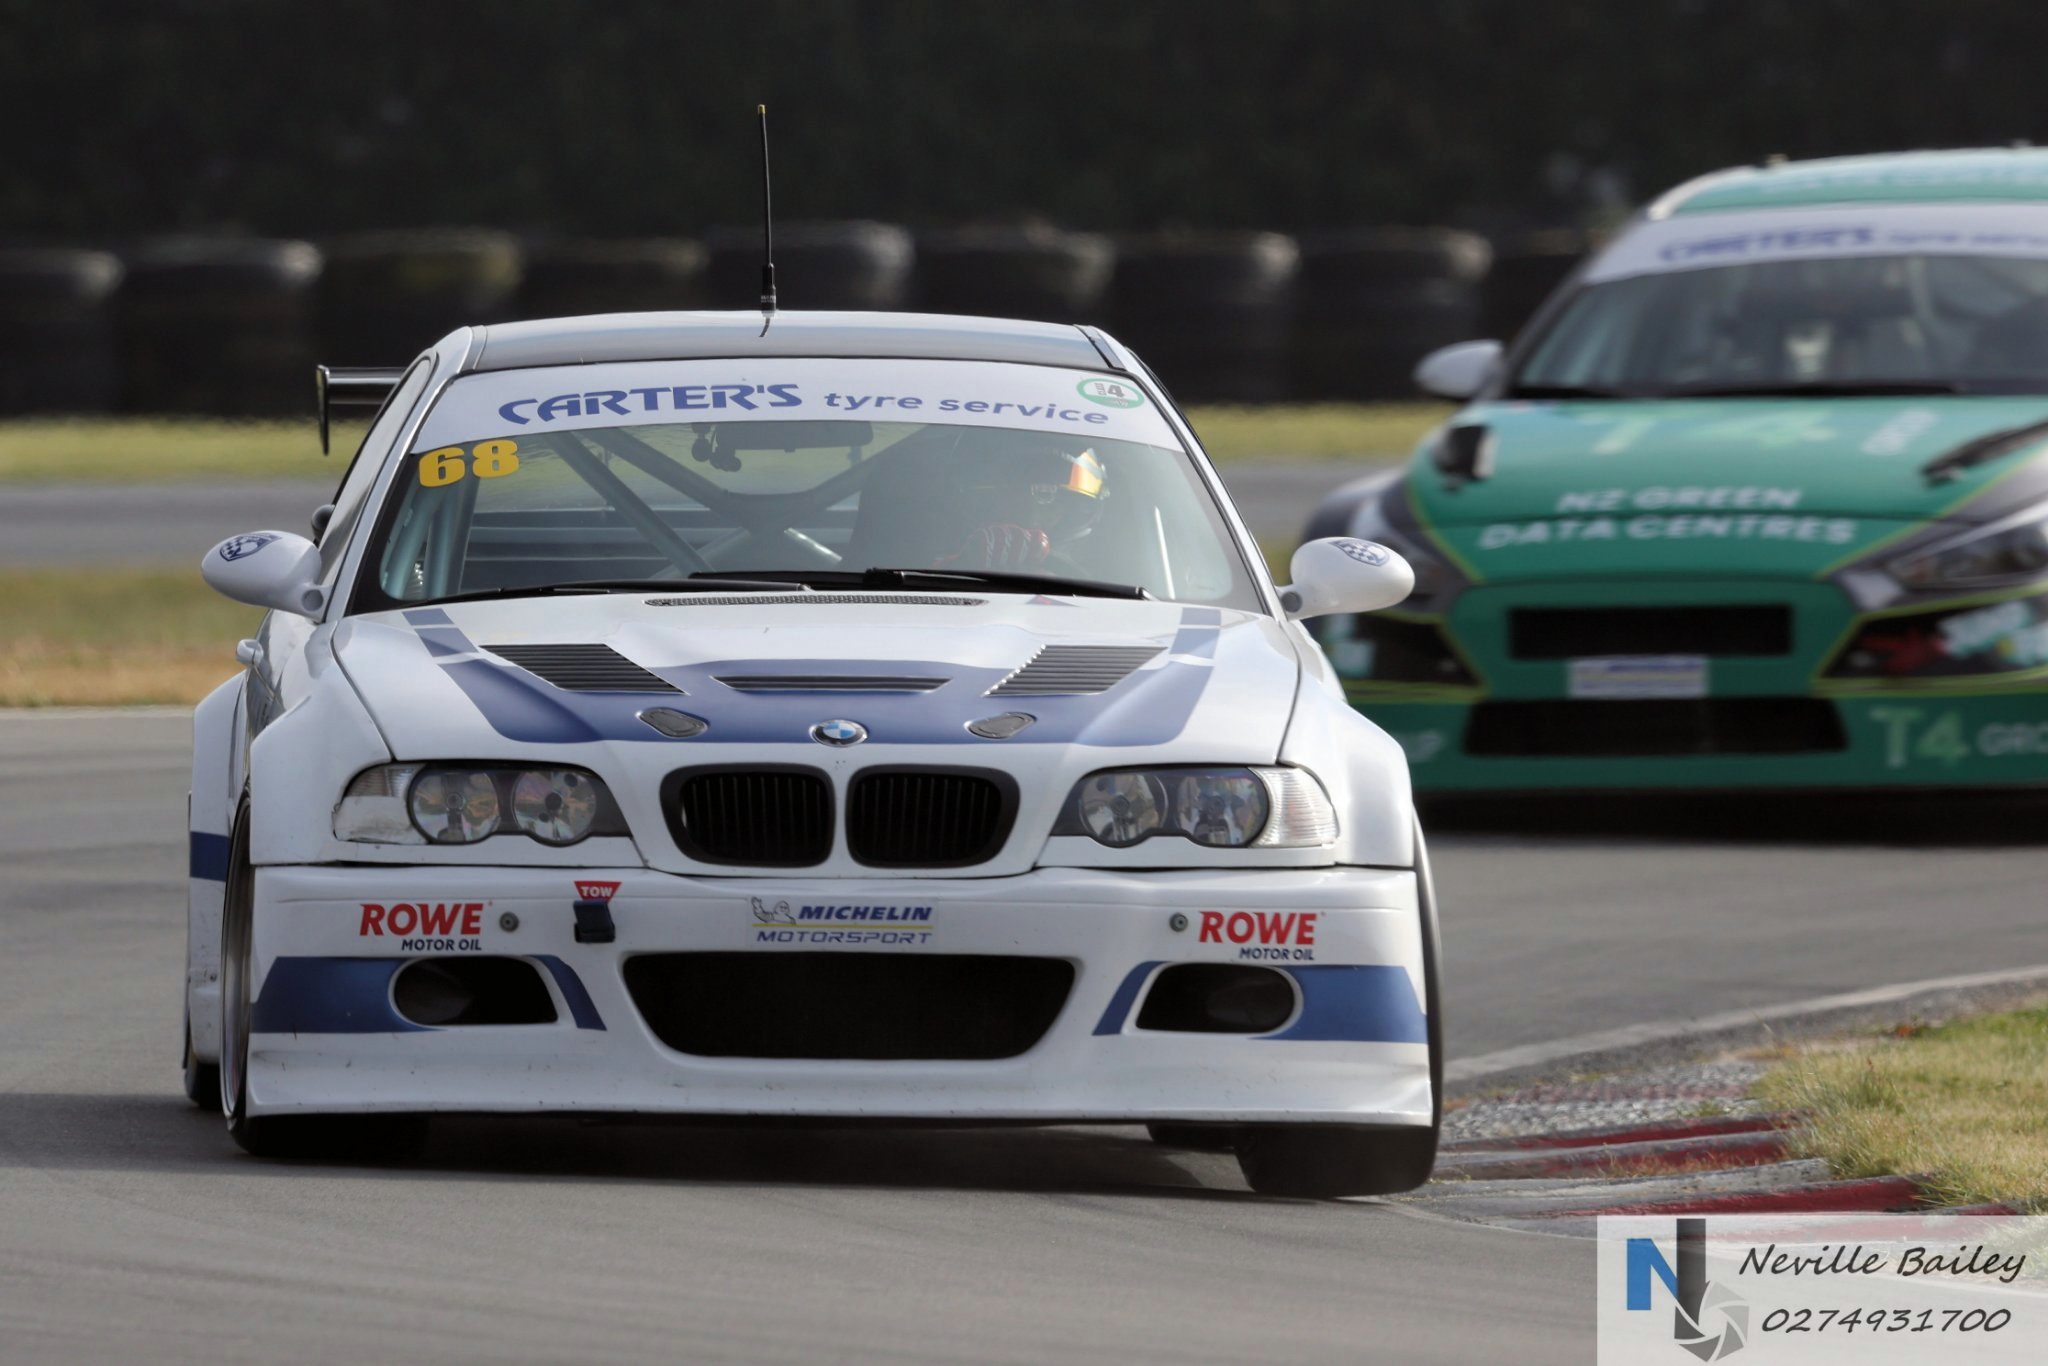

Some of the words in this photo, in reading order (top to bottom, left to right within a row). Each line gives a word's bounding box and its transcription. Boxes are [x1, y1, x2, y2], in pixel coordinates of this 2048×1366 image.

[497, 383, 803, 425] CARTER'S
[824, 391, 924, 411] tyre
[938, 398, 1110, 424] service
[418, 439, 520, 488] 68
[1633, 485, 1801, 511] GREEN
[1479, 519, 1616, 549] DATA
[1625, 512, 1857, 546] CENTRES
[1869, 706, 1969, 769] T4
[581, 886, 613, 898] TOW
[359, 903, 484, 937] ROWE
[798, 906, 933, 921] MICHELIN
[1198, 911, 1318, 946] ROWE
[401, 938, 455, 952] MOTOR
[458, 938, 483, 952] OIL
[756, 930, 933, 944] MOTORSPORT
[1239, 947, 1289, 960] MOTOR
[1292, 948, 1315, 961] OIL
